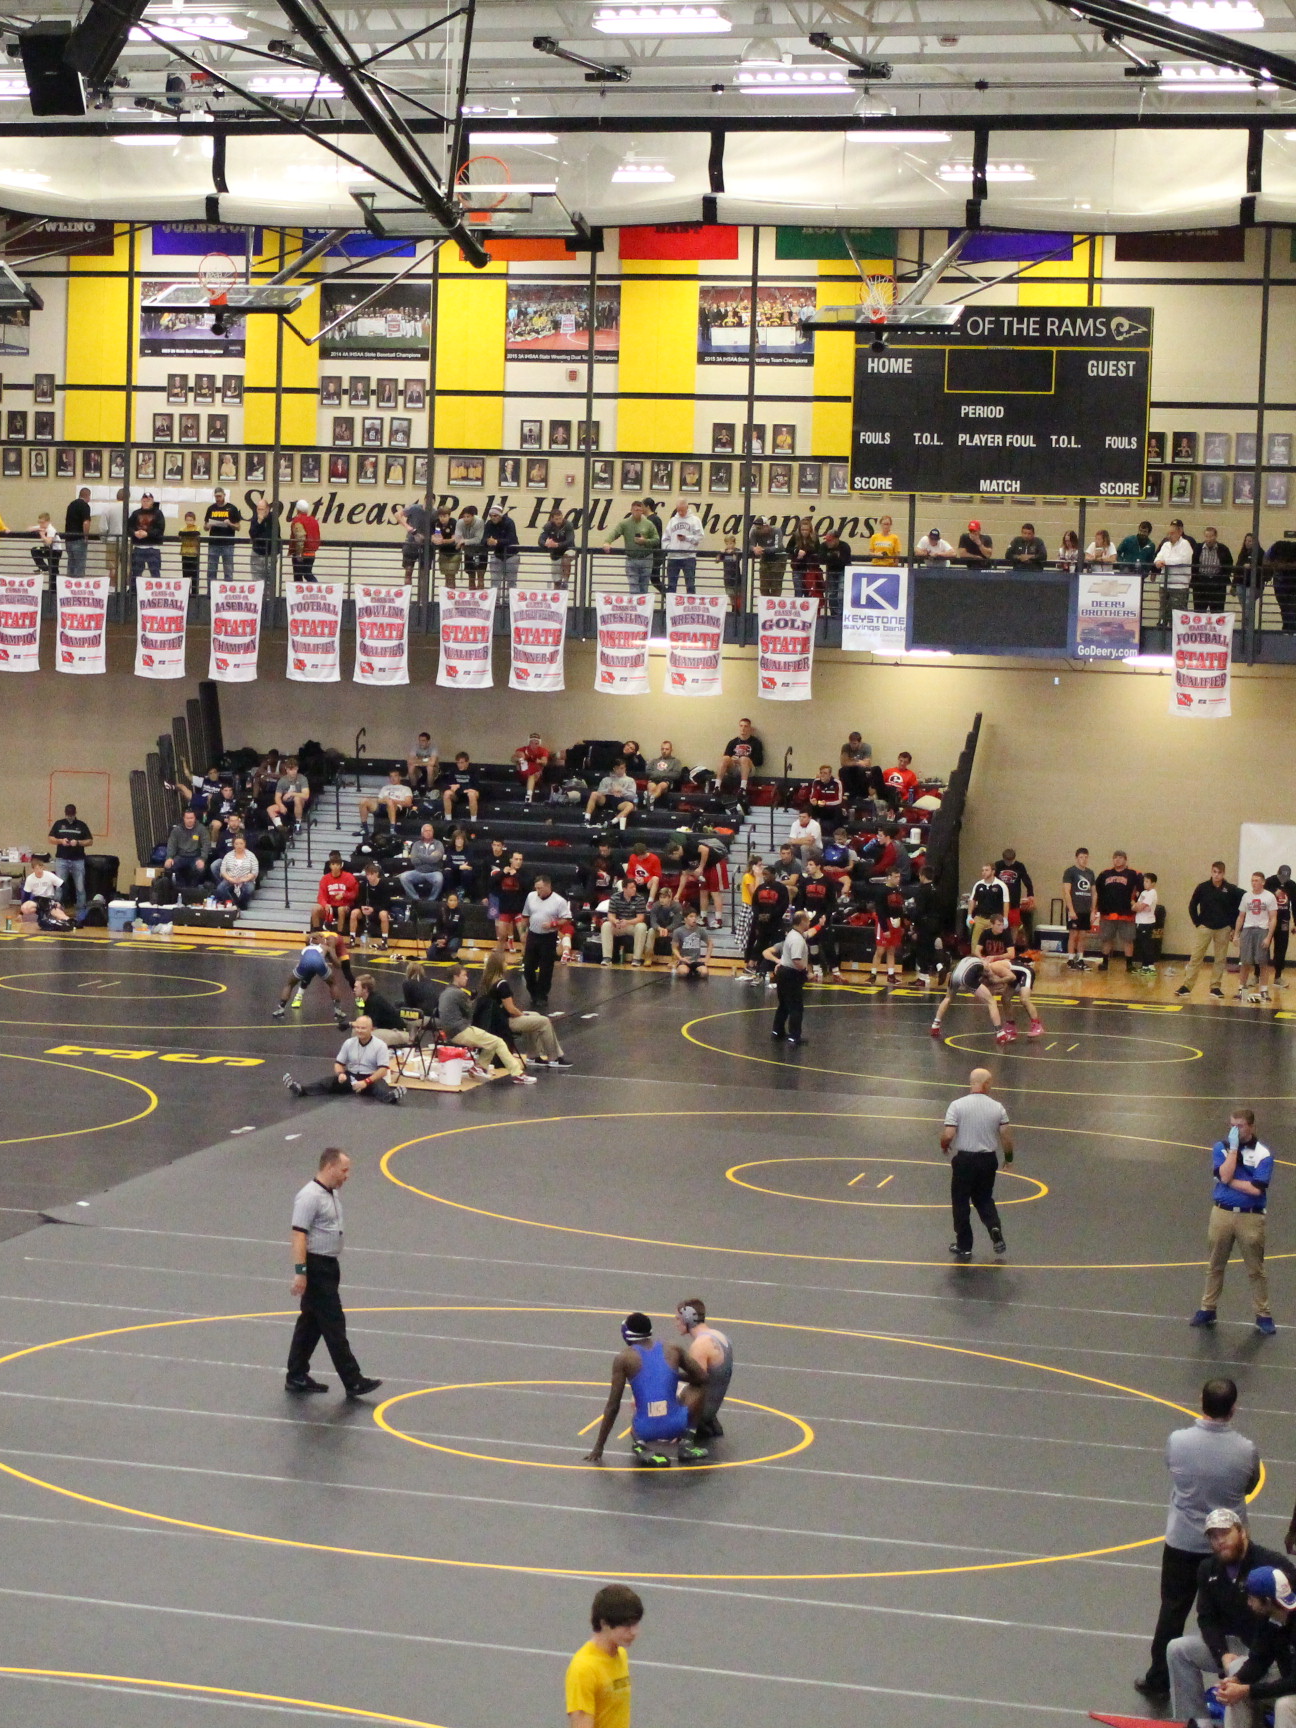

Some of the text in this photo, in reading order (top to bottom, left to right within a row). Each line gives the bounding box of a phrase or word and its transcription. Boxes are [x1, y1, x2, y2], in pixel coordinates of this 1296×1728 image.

[967, 317, 994, 336] OF
[1000, 318, 1039, 336] THE
[1046, 319, 1106, 337] RAMS
[868, 358, 912, 373] HOME
[1087, 361, 1136, 377] GUEST
[961, 406, 1004, 418] PERIOD
[860, 432, 890, 444] FOULS
[913, 434, 943, 445] T.O.L.
[958, 434, 1036, 447] PLAYER FOUL
[1051, 436, 1081, 448] T.O.L.
[1105, 437, 1137, 449] FOULS
[855, 477, 892, 489] SCORE
[980, 480, 1020, 492] MATCH
[1100, 483, 1139, 495] SCORE
[860, 578, 896, 611] K
[140, 598, 184, 611] BASEBALL
[289, 601, 338, 616] FOOTBALL
[766, 600, 810, 610] 2016
[358, 604, 404, 621] BOWLING
[844, 614, 905, 625] KEYSTONE
[1081, 609, 1136, 617] BROTHERS
[61, 612, 104, 630] STATE
[141, 614, 184, 634] STATE
[214, 618, 257, 637] STATE
[289, 618, 338, 637] STATE
[670, 614, 721, 628] WRESTLING
[761, 618, 812, 632] GOLF
[358, 621, 404, 640] STATE
[442, 624, 489, 643] STATE
[513, 626, 562, 646] STATE
[669, 631, 720, 650] STATE
[760, 635, 810, 655] STATE
[1177, 633, 1229, 647] FOOTBALL
[1077, 645, 1138, 658] GoDeery.com
[1176, 650, 1228, 670] STATE
